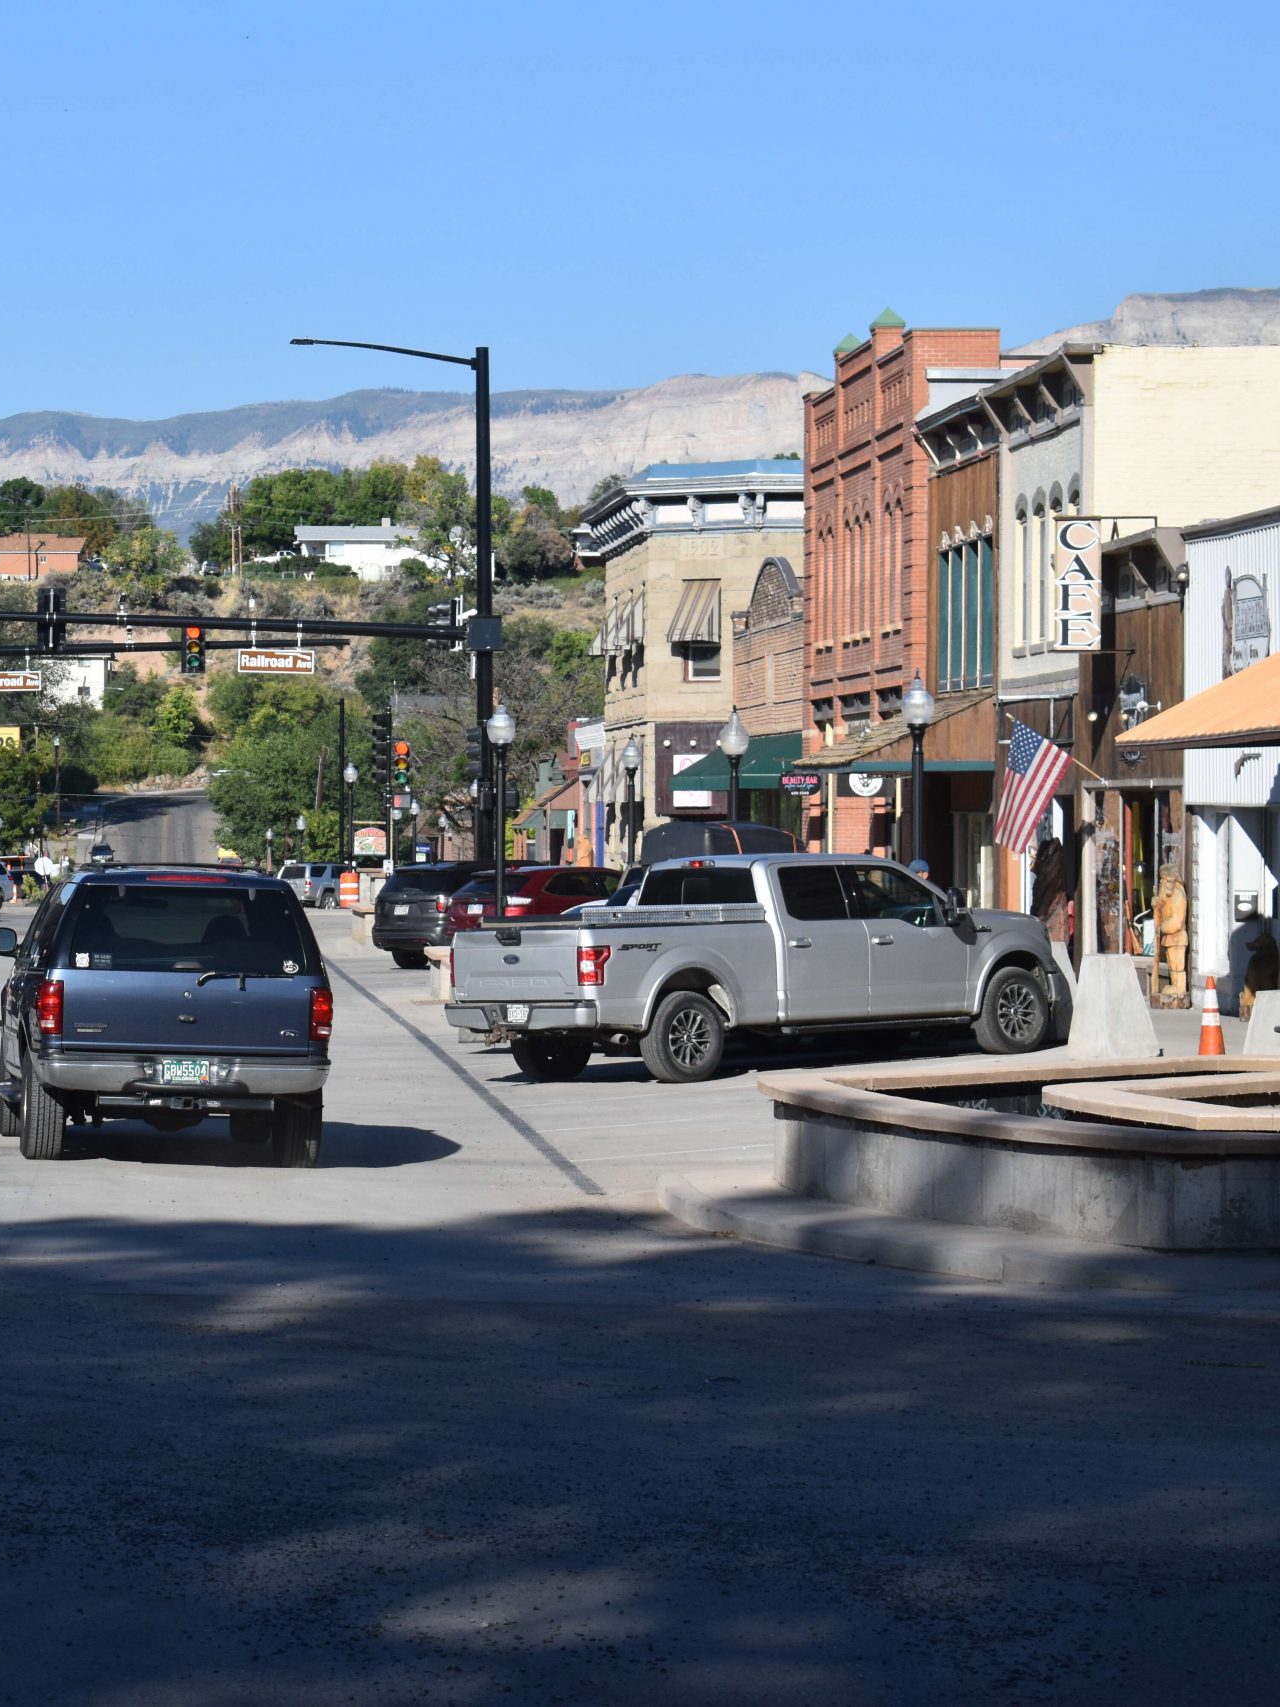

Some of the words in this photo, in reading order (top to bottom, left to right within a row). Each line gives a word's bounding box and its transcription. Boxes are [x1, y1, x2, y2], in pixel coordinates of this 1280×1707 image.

[241, 654, 293, 668] Railroad
[296, 660, 312, 668] Ave
[782, 776, 804, 785] BEAUTY
[806, 776, 818, 784] BAR
[617, 942, 663, 951] SPORT
[164, 1064, 207, 1077] GBW5504
